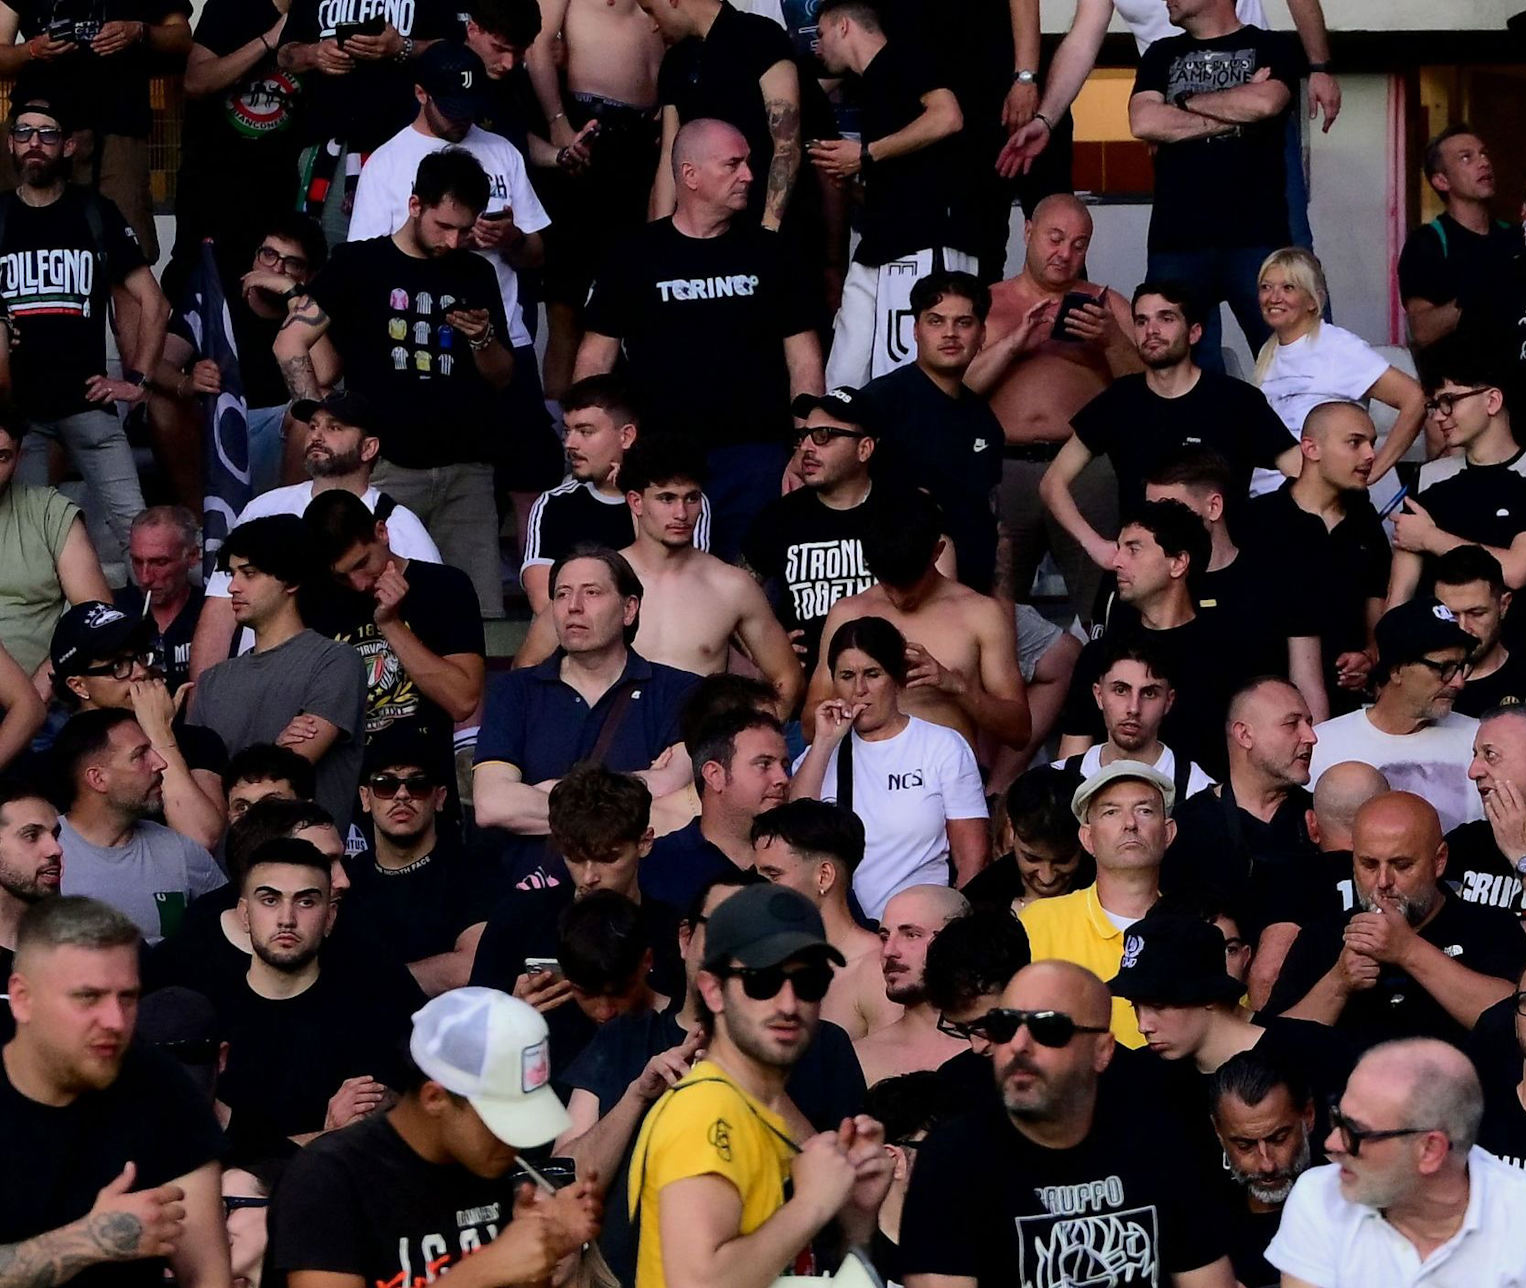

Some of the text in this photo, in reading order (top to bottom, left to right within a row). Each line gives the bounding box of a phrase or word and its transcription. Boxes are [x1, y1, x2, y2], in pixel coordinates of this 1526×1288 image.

[1172, 71, 1252, 85] AMPIONE
[785, 540, 872, 584] STRON
[887, 769, 923, 791] NCS
